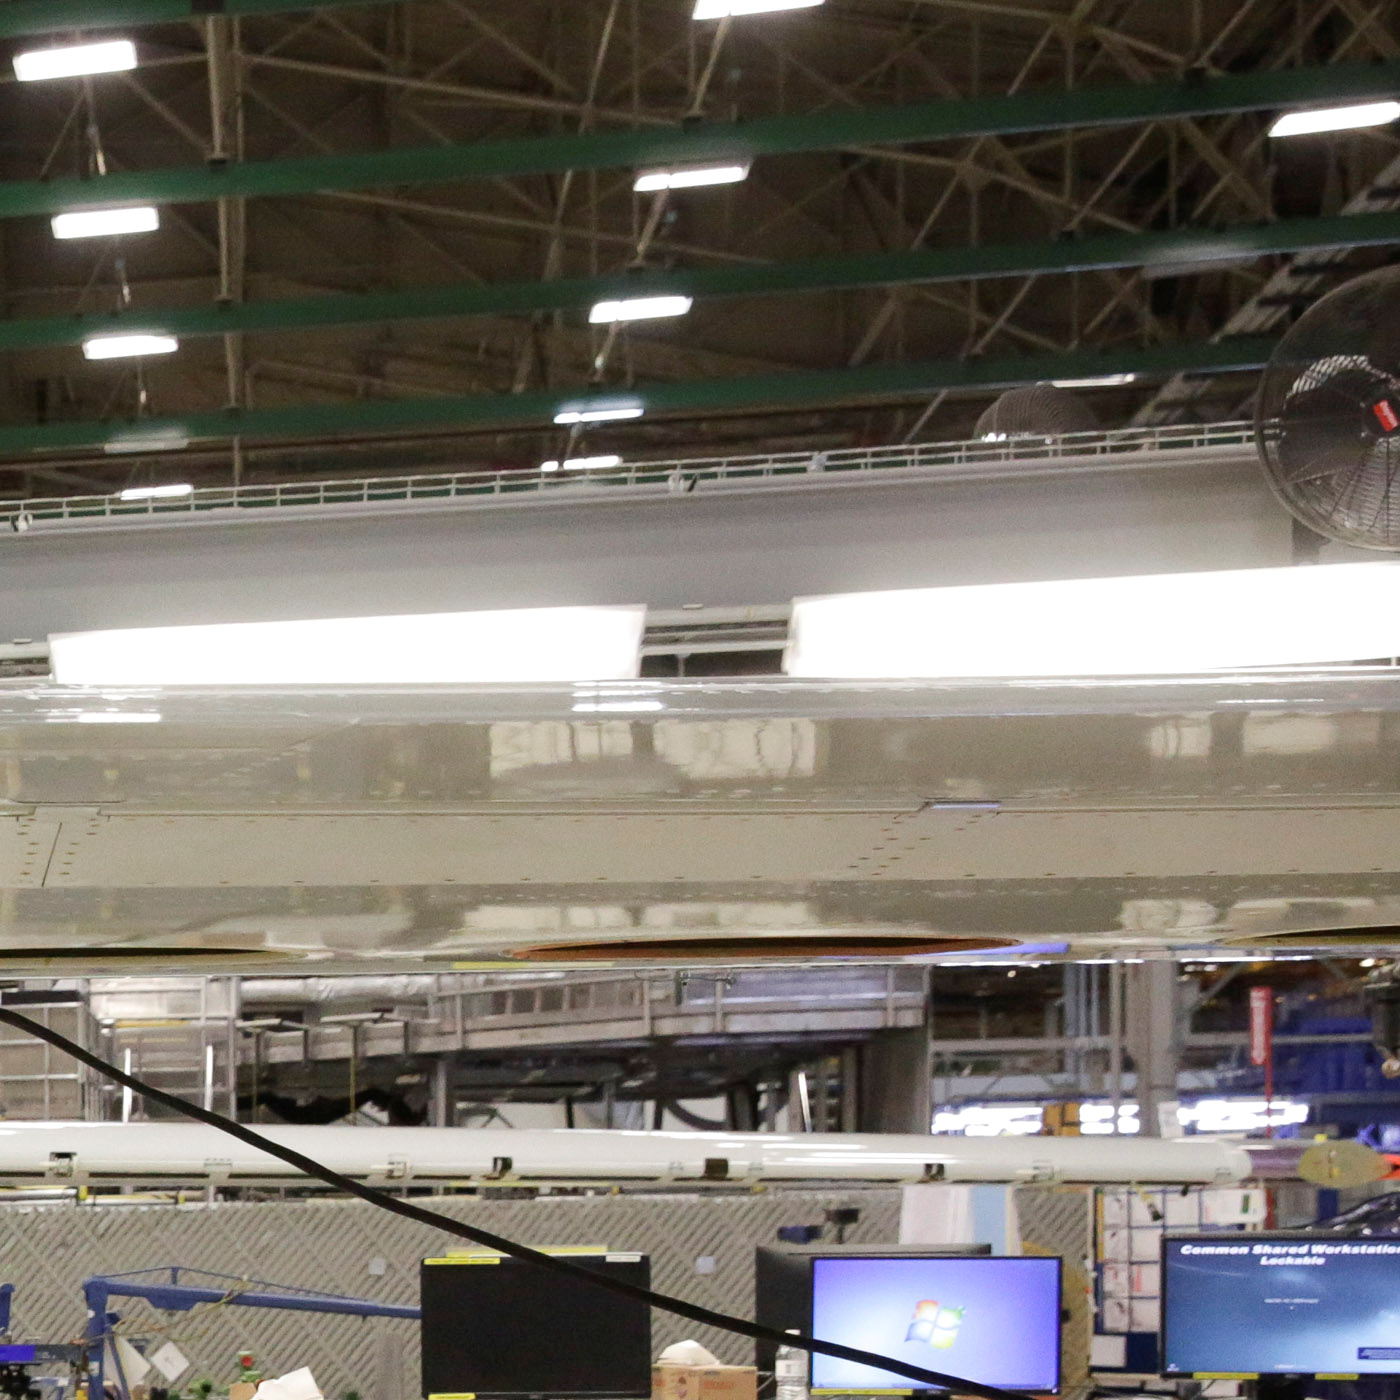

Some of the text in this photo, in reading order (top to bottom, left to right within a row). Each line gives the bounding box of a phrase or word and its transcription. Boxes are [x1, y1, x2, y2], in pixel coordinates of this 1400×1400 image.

[1180, 1245, 1250, 1255] Common
[1252, 1244, 1309, 1255] Shared
[1260, 1256, 1326, 1266] Lockable
